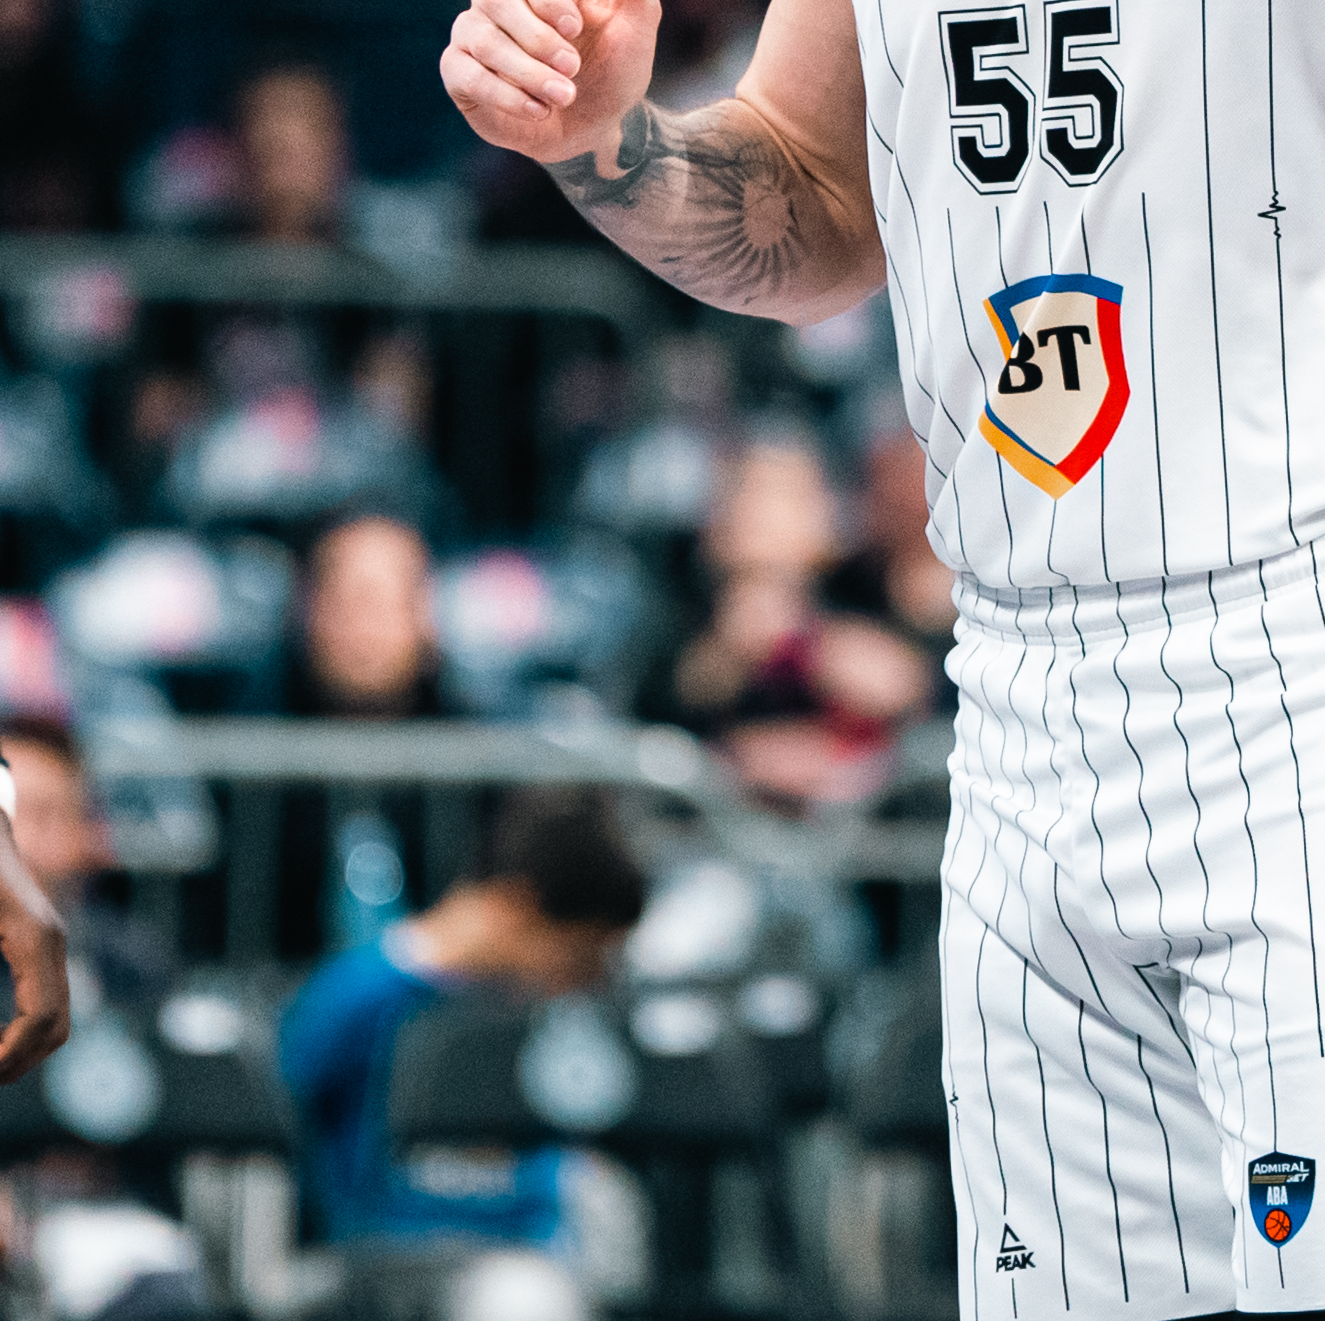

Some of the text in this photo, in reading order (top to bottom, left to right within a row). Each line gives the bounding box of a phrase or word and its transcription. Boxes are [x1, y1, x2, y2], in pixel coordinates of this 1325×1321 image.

[997, 325, 1092, 395] BT
[1252, 1161, 1310, 1175] ADMIRAL
[1266, 1185, 1289, 1206] ABA
[995, 1251, 1036, 1273] PEAK
